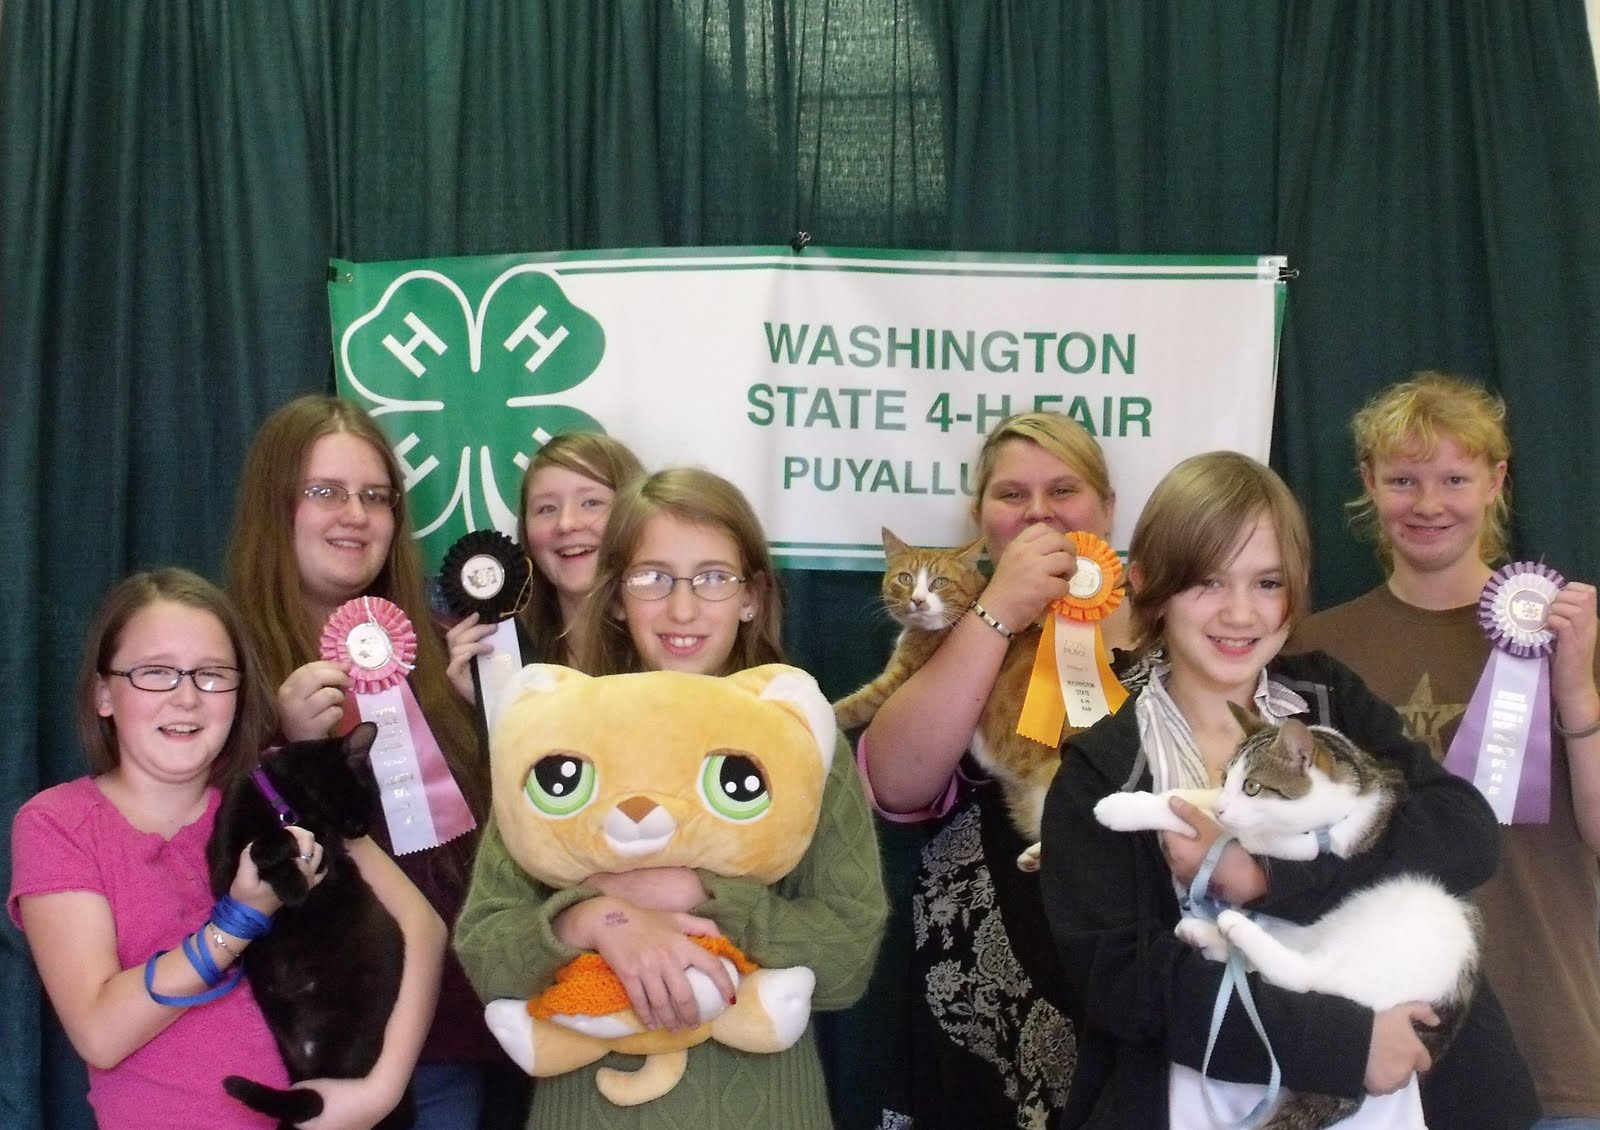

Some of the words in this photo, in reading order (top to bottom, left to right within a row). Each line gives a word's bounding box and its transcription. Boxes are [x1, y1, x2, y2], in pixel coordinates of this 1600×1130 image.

[382, 311, 448, 378] H
[503, 304, 570, 373] H
[764, 321, 1136, 375] WASHINGTON
[747, 383, 907, 431] STATE
[926, 392, 1010, 434] 4-H
[783, 456, 977, 496] PUYALLU
